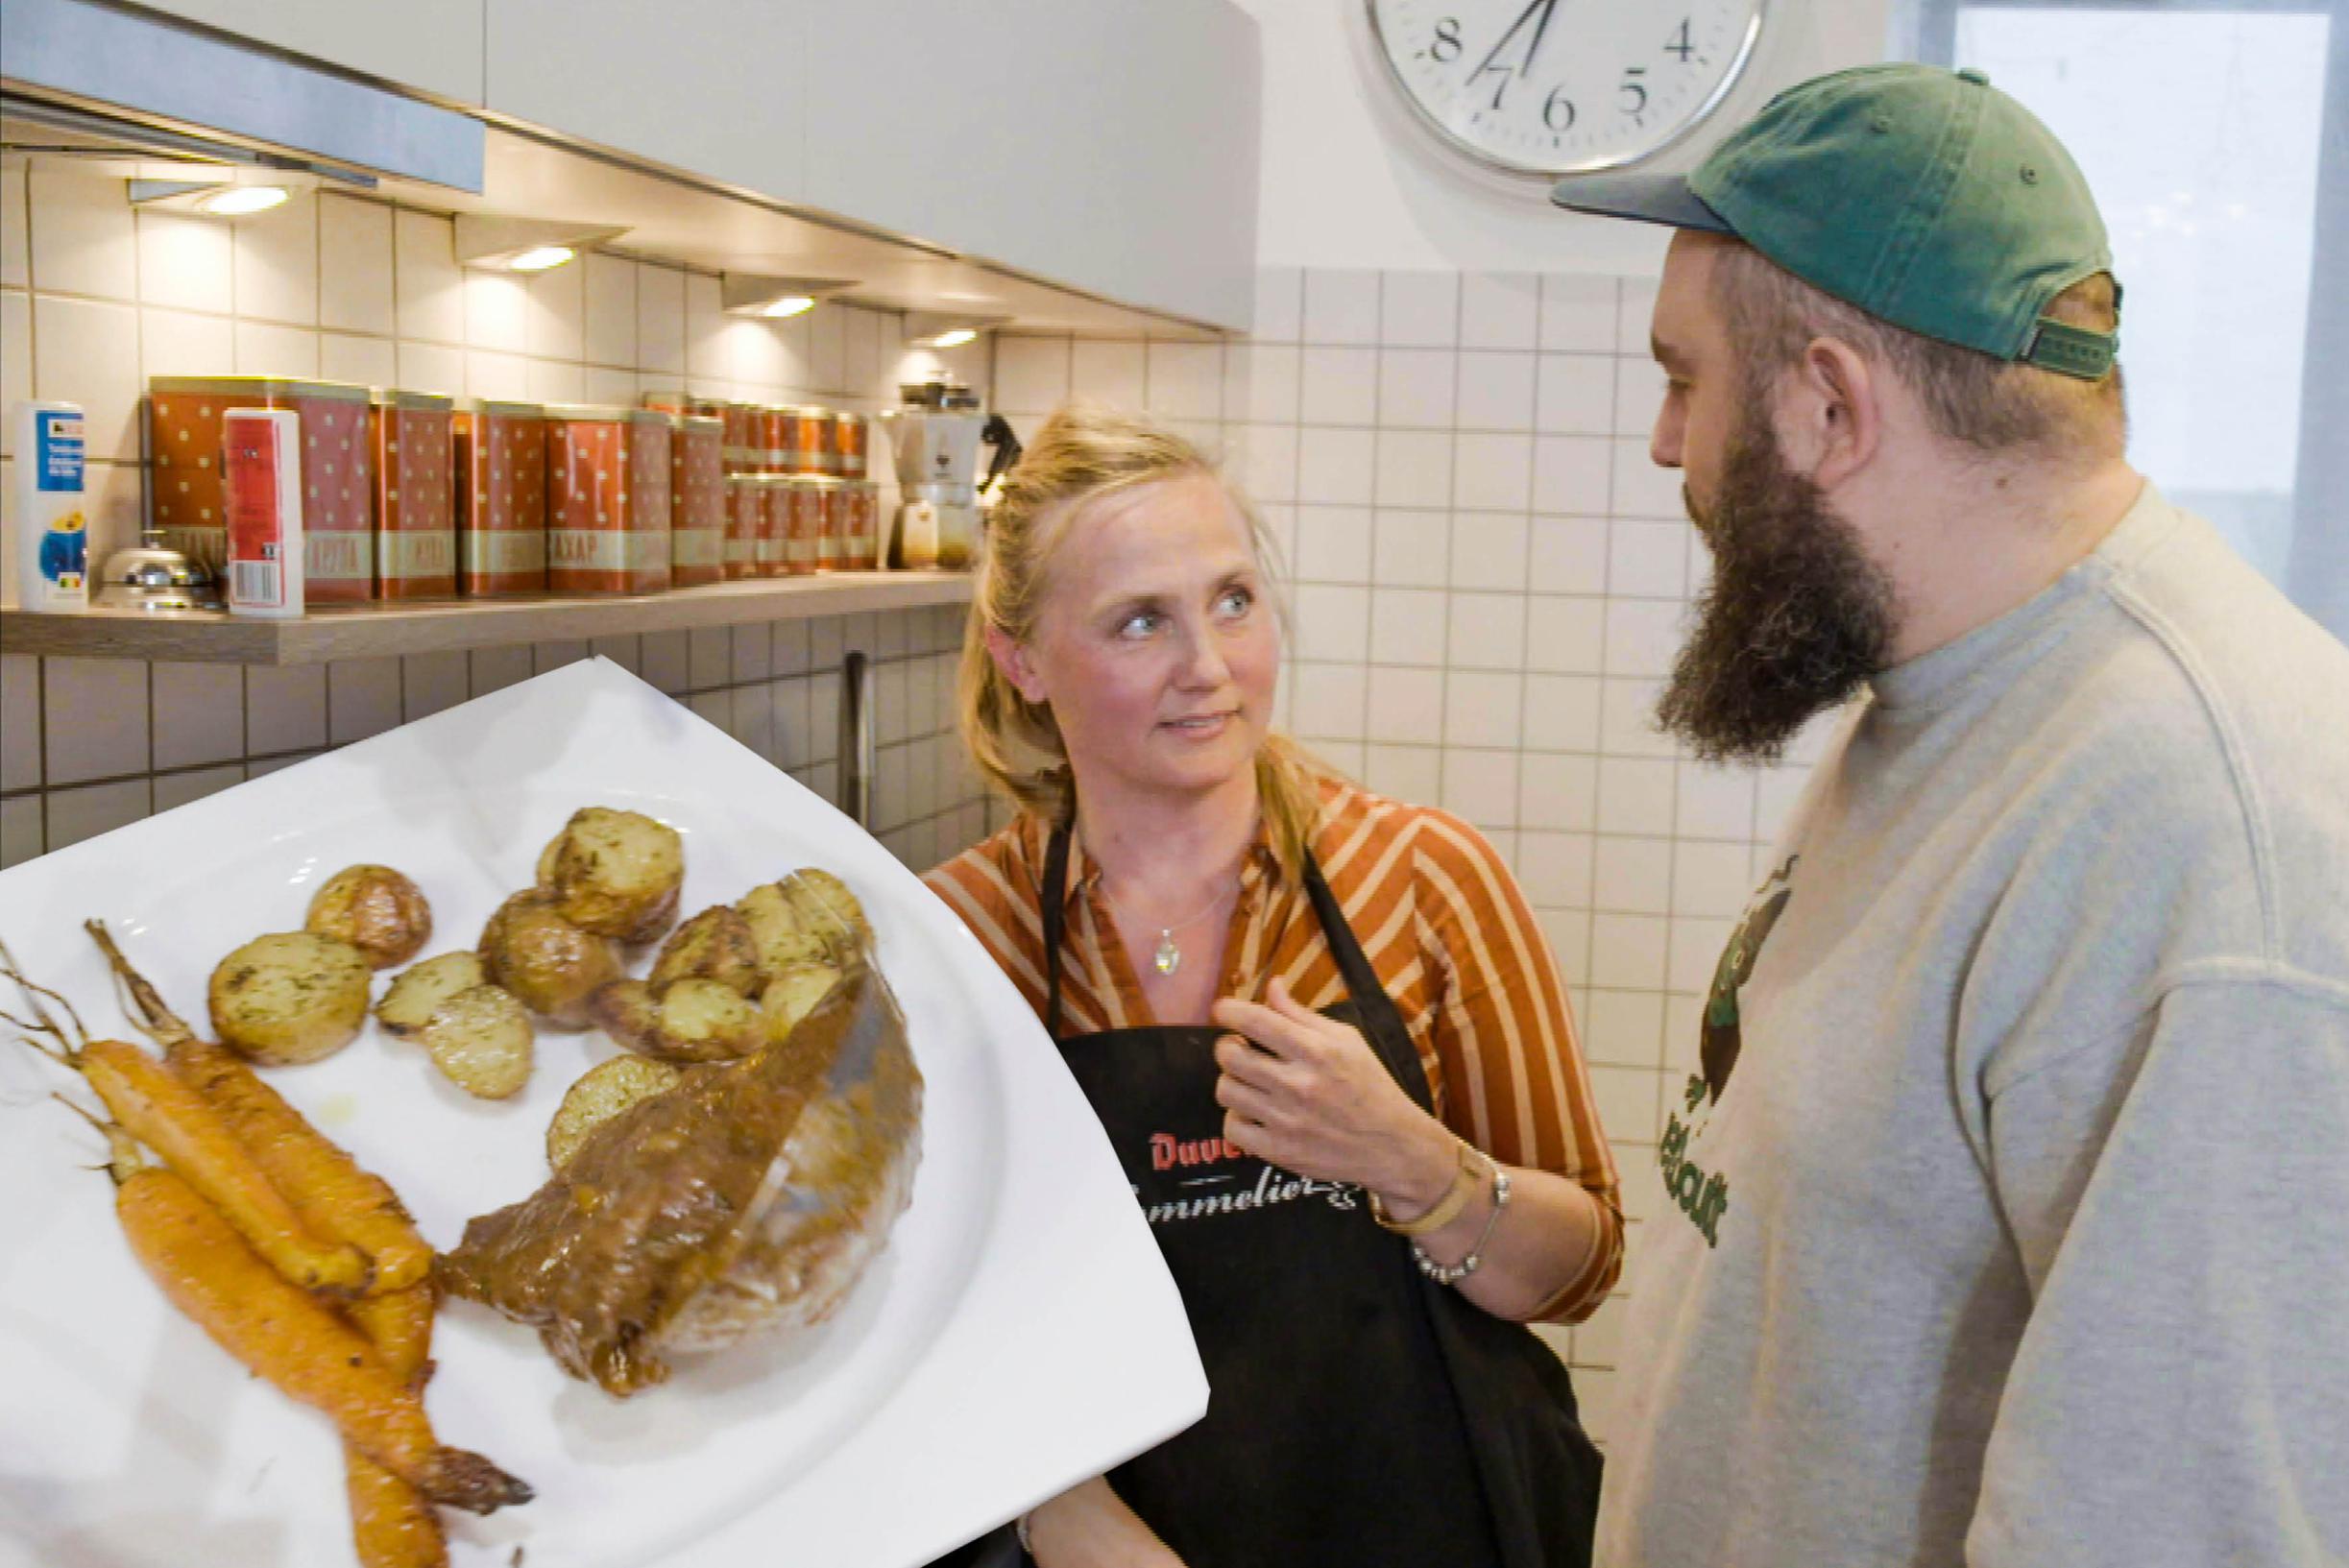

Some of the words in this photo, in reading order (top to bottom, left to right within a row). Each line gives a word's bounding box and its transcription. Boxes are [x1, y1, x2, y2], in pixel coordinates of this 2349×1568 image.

[1430, 16, 1464, 62] 8
[1662, 15, 1696, 62] 4
[1487, 66, 1514, 110] 7
[1542, 80, 1577, 132] 6
[1619, 66, 1648, 114] 5
[1150, 1132, 1243, 1170] Duve
